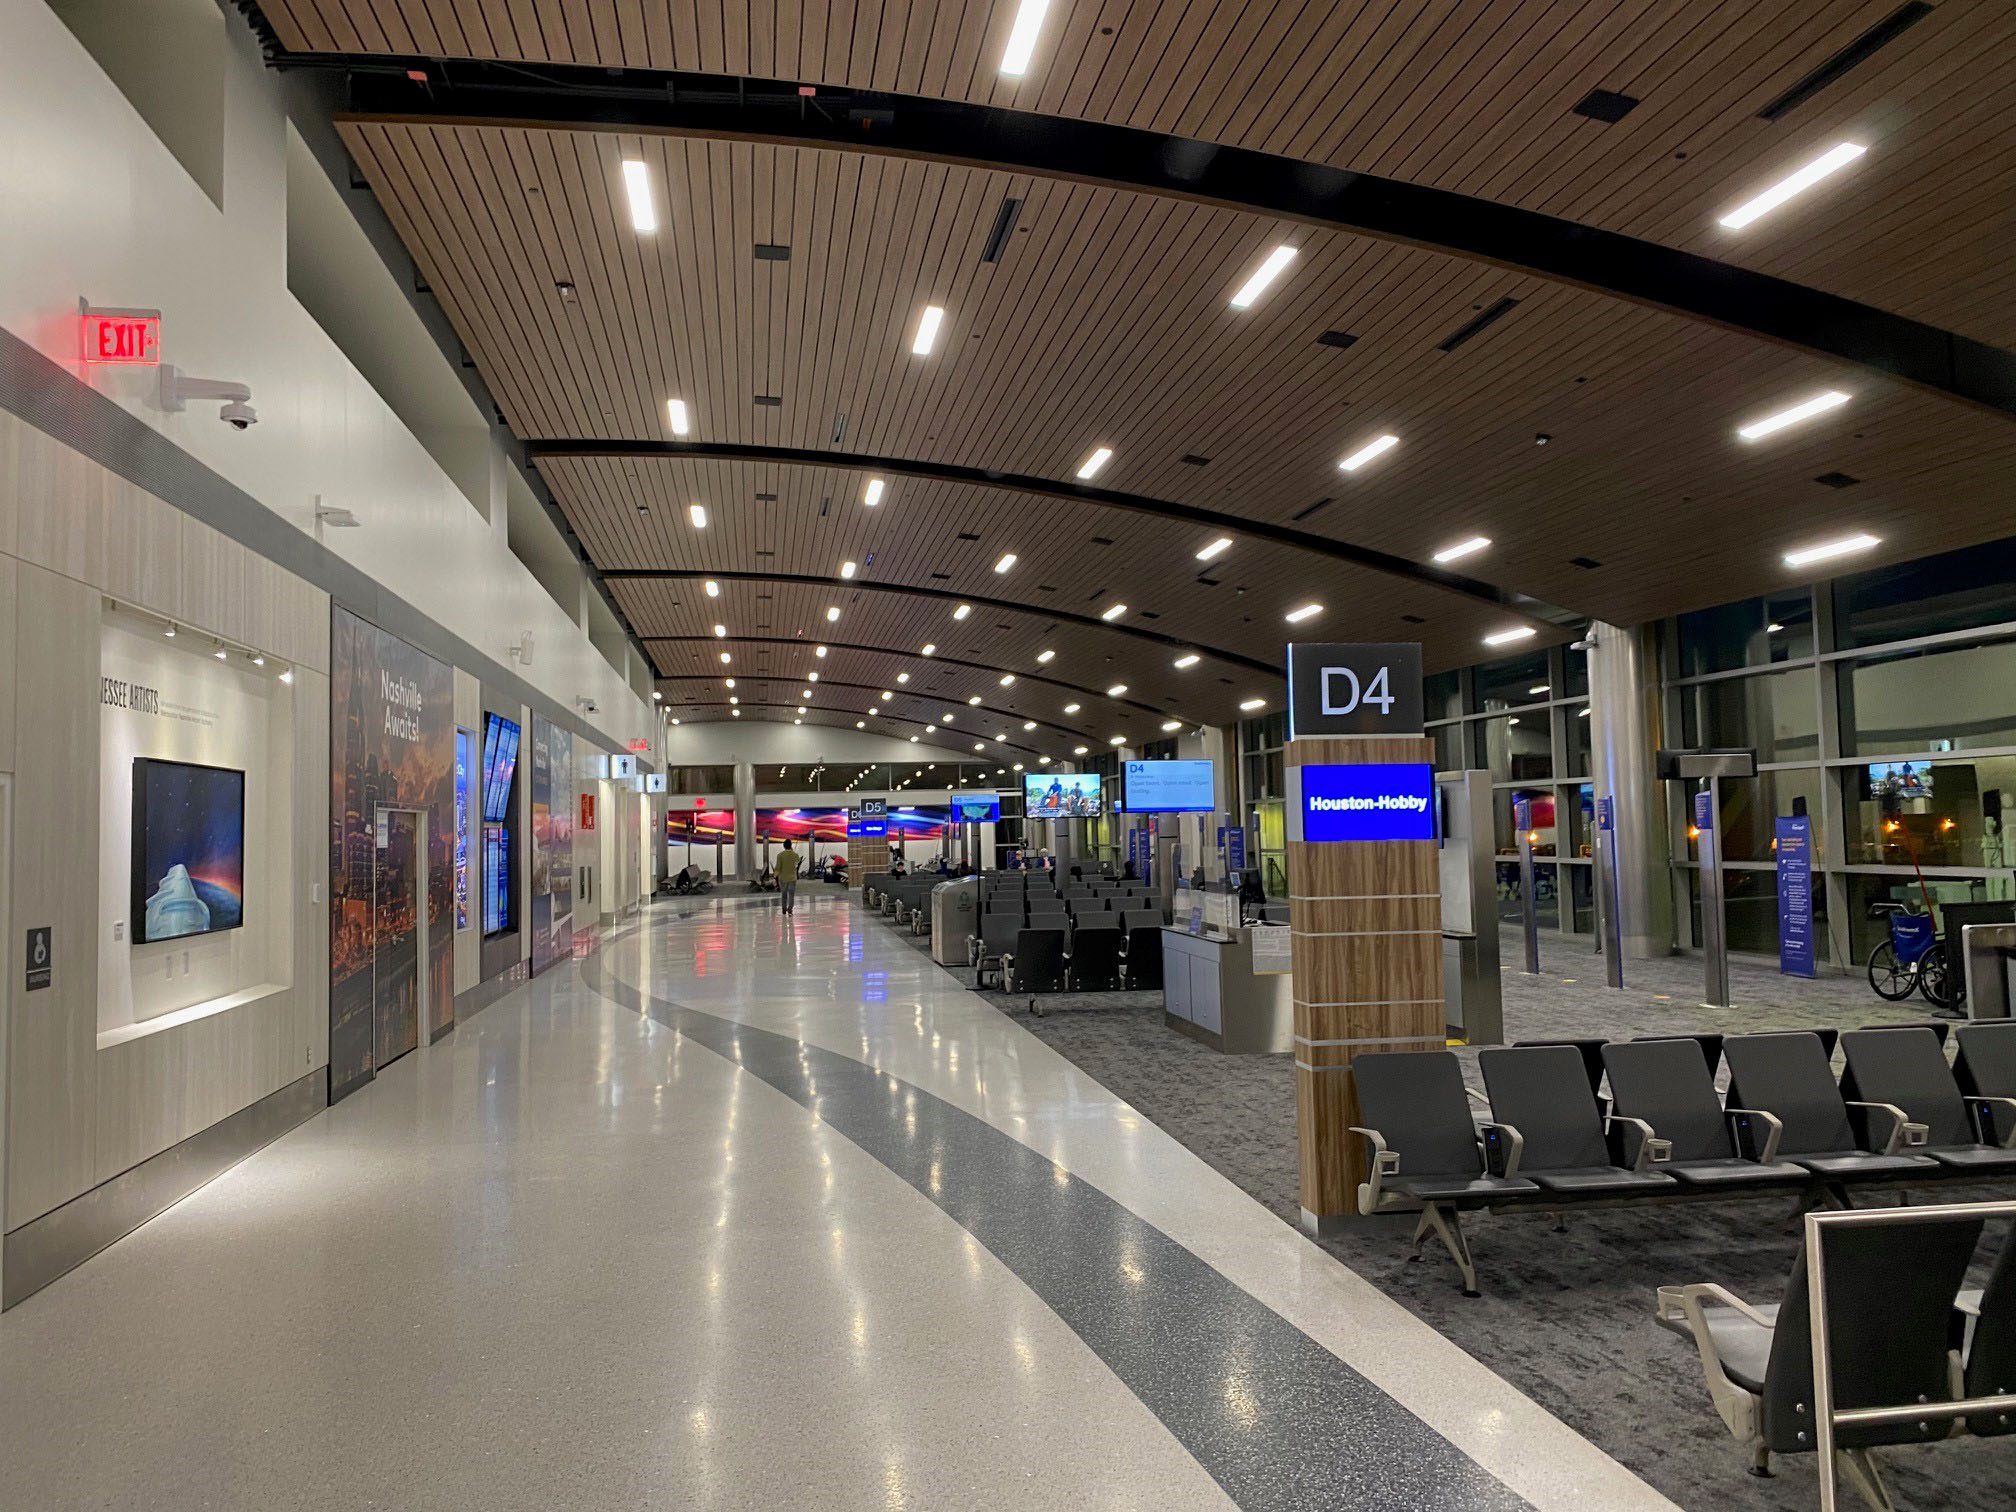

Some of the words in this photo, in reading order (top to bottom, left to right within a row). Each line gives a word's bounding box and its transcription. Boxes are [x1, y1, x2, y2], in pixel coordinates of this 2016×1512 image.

[99, 322, 146, 357] EXIT
[128, 684, 159, 714] ARTISTS
[381, 669, 422, 712] Nashville
[1320, 666, 1395, 716] D4
[384, 705, 419, 742] Awaits!
[1130, 763, 1144, 773] D4
[866, 802, 881, 813] D5
[1309, 795, 1428, 813] Houston-Hobby
